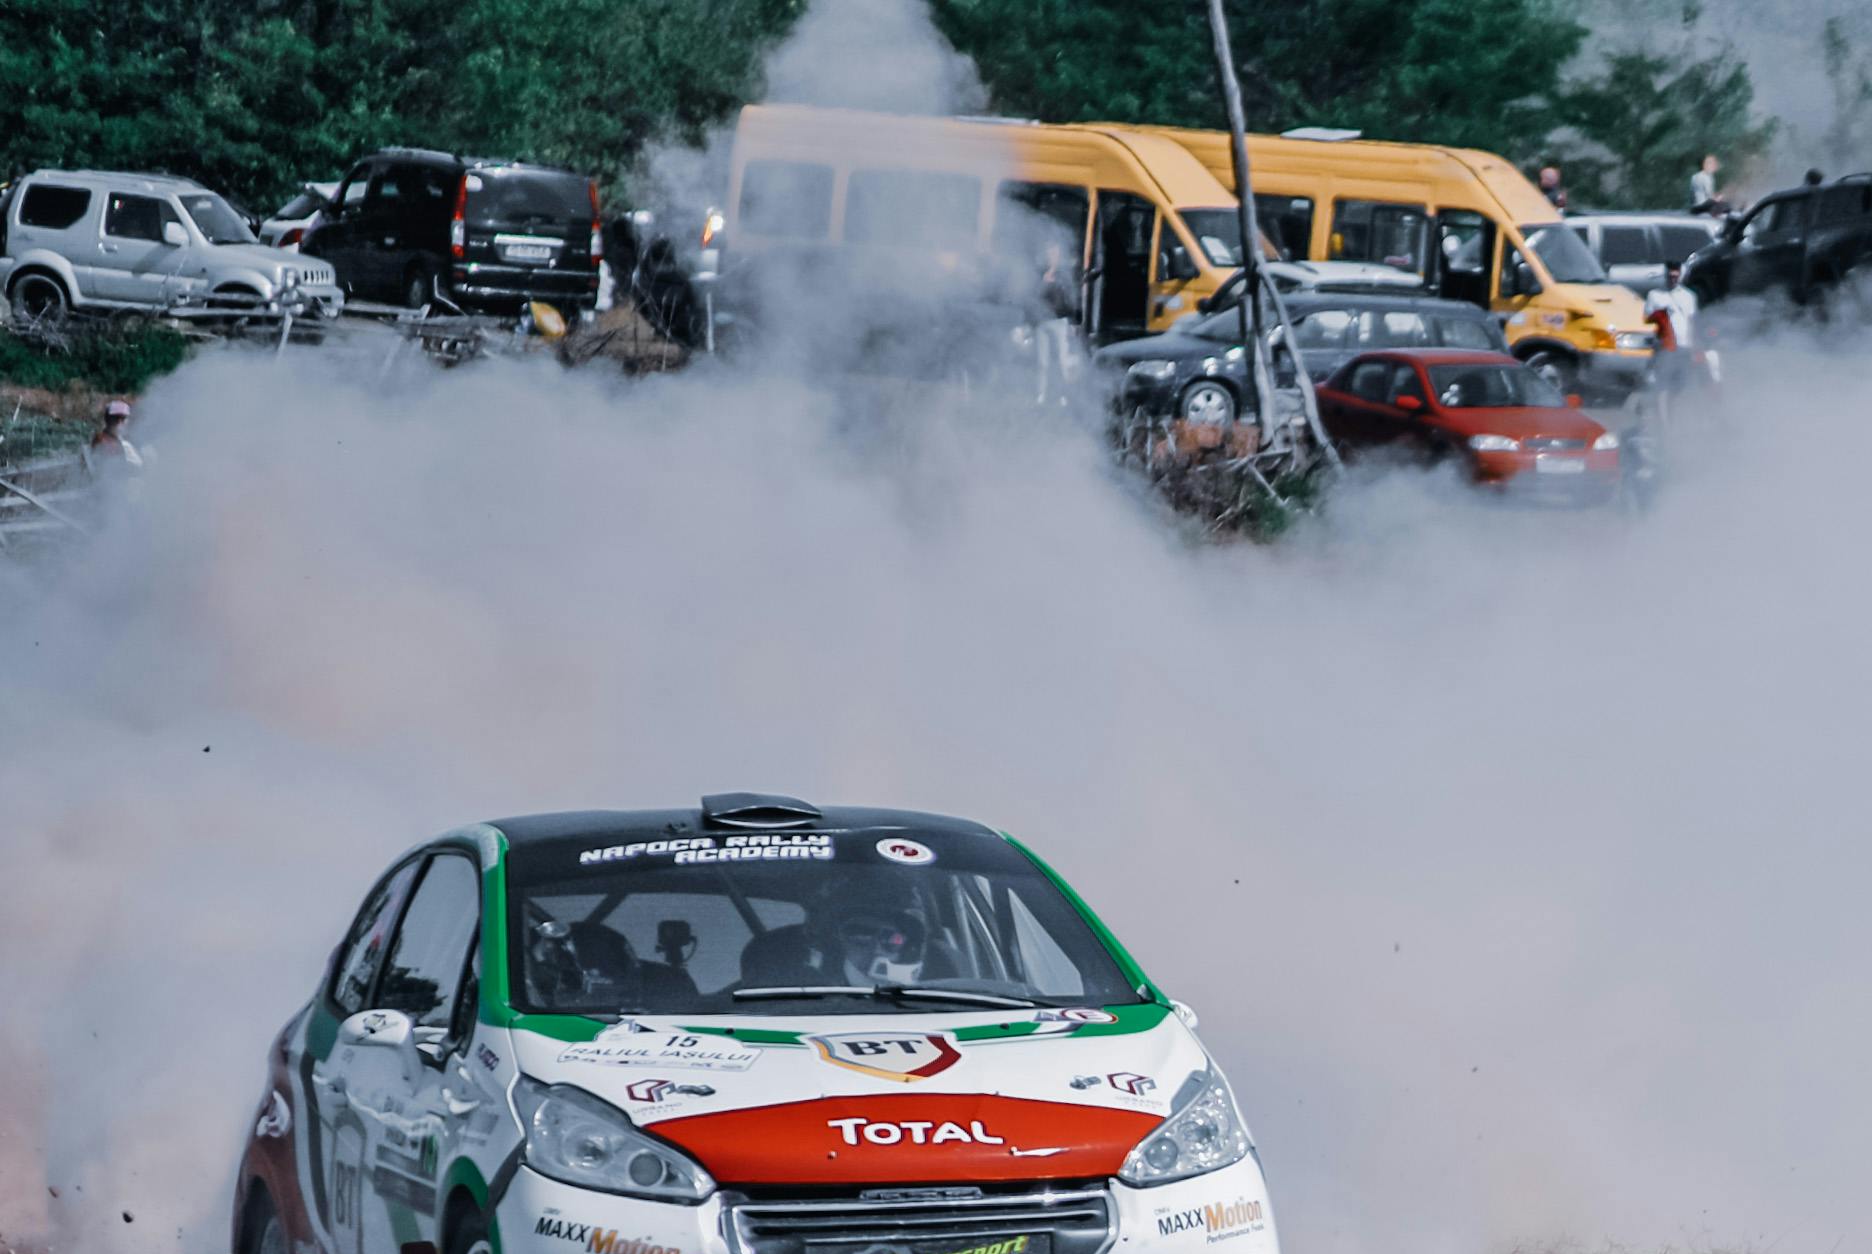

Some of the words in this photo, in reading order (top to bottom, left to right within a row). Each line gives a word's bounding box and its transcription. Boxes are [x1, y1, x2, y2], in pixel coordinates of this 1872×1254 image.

[579, 837, 714, 864] NAPOCA
[725, 835, 832, 847] RALLY
[673, 846, 834, 864] ACADEMY
[666, 1035, 701, 1048] 15
[842, 1039, 923, 1056] BT
[336, 1161, 356, 1229] BT
